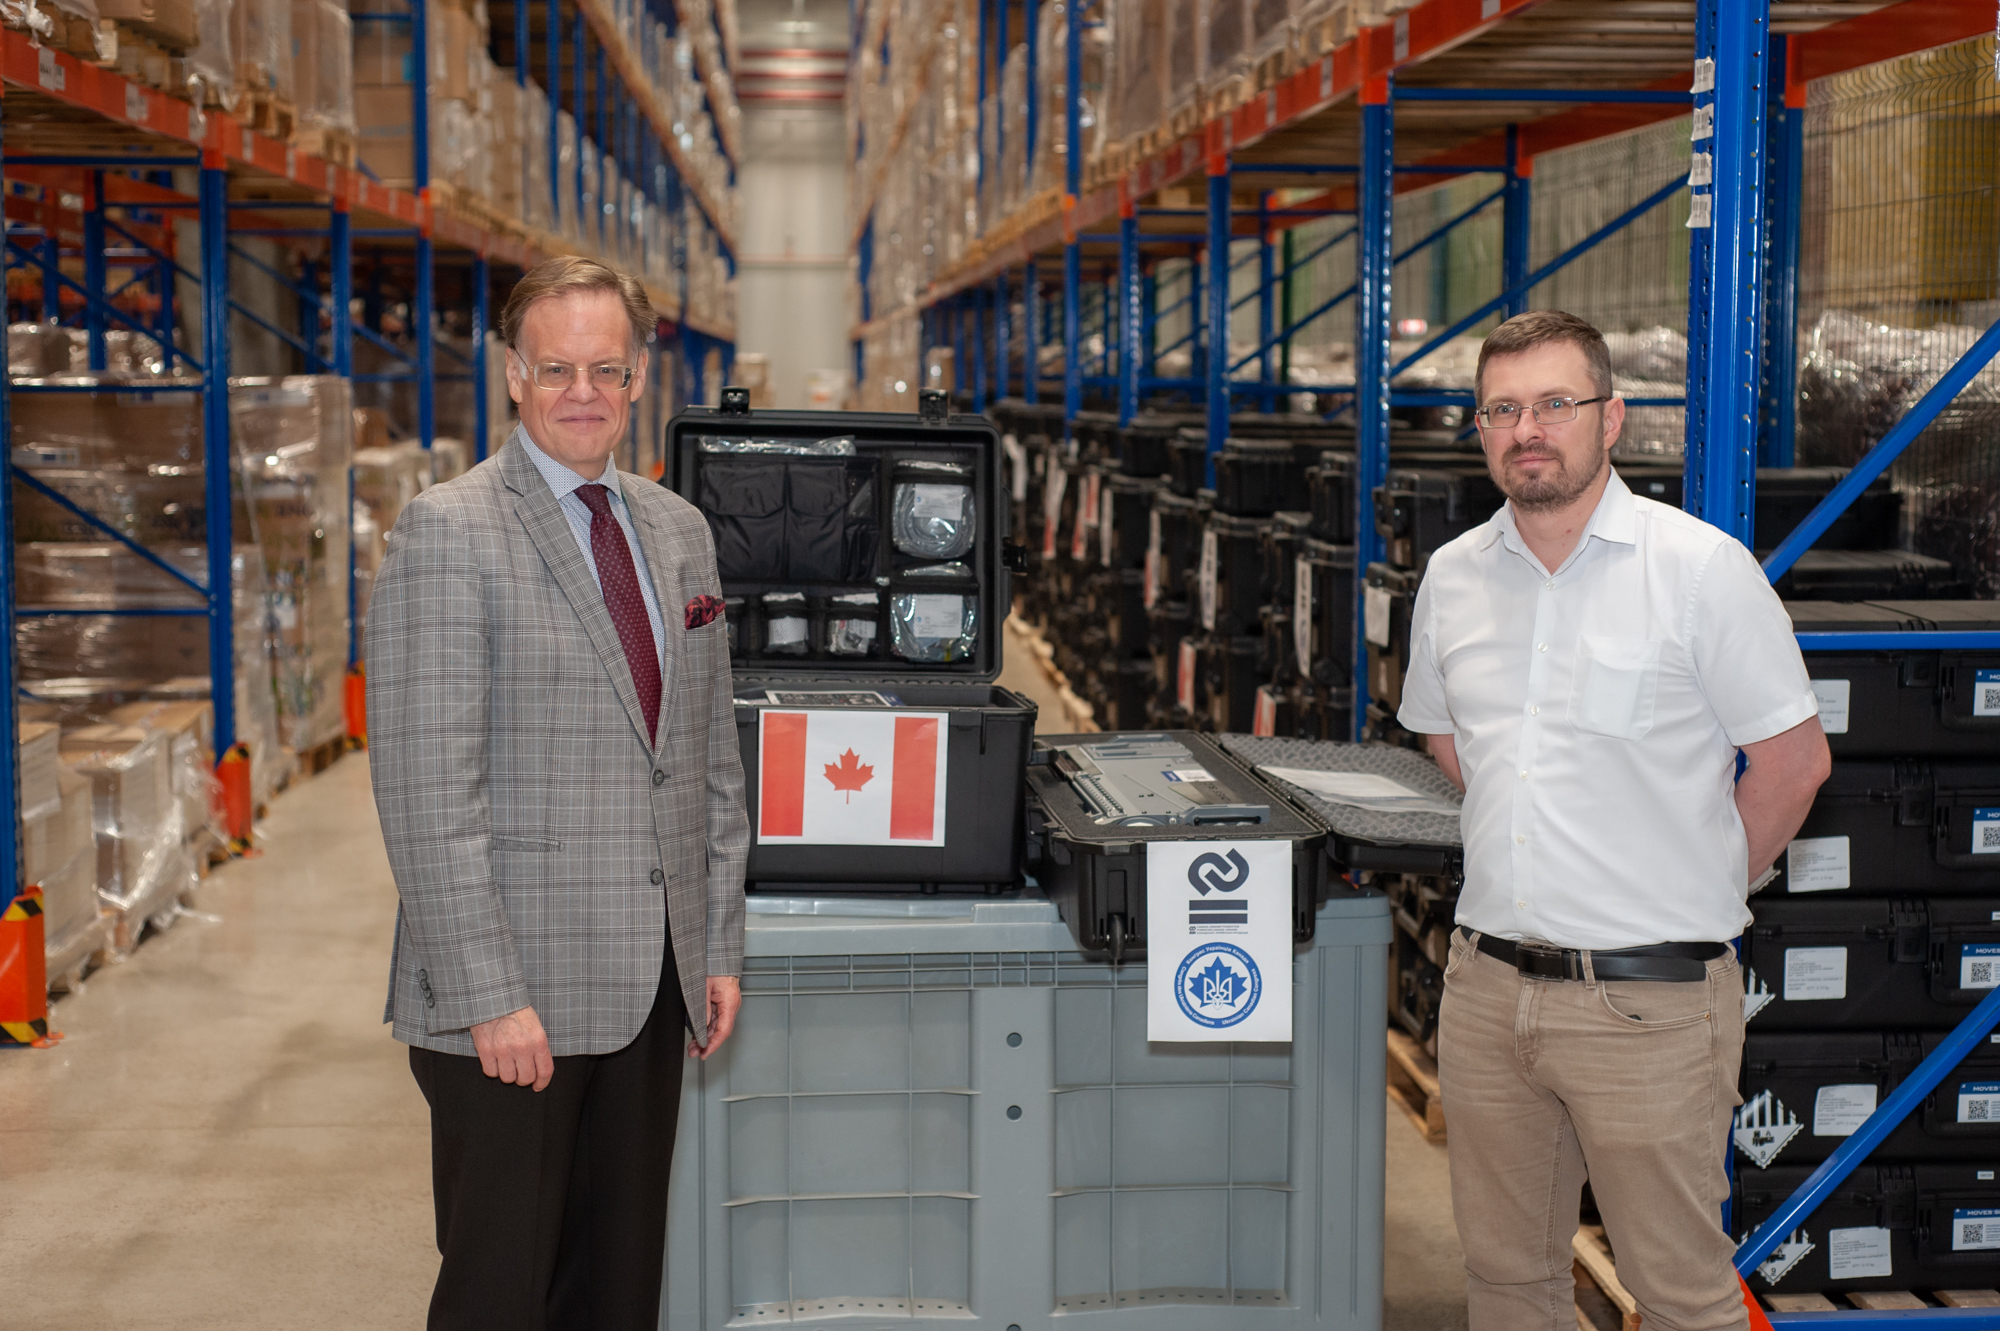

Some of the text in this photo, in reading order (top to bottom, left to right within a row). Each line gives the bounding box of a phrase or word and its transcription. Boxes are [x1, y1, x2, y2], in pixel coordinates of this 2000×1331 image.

[1221, 968, 1260, 1025] Ukrainian Canadian Congress
